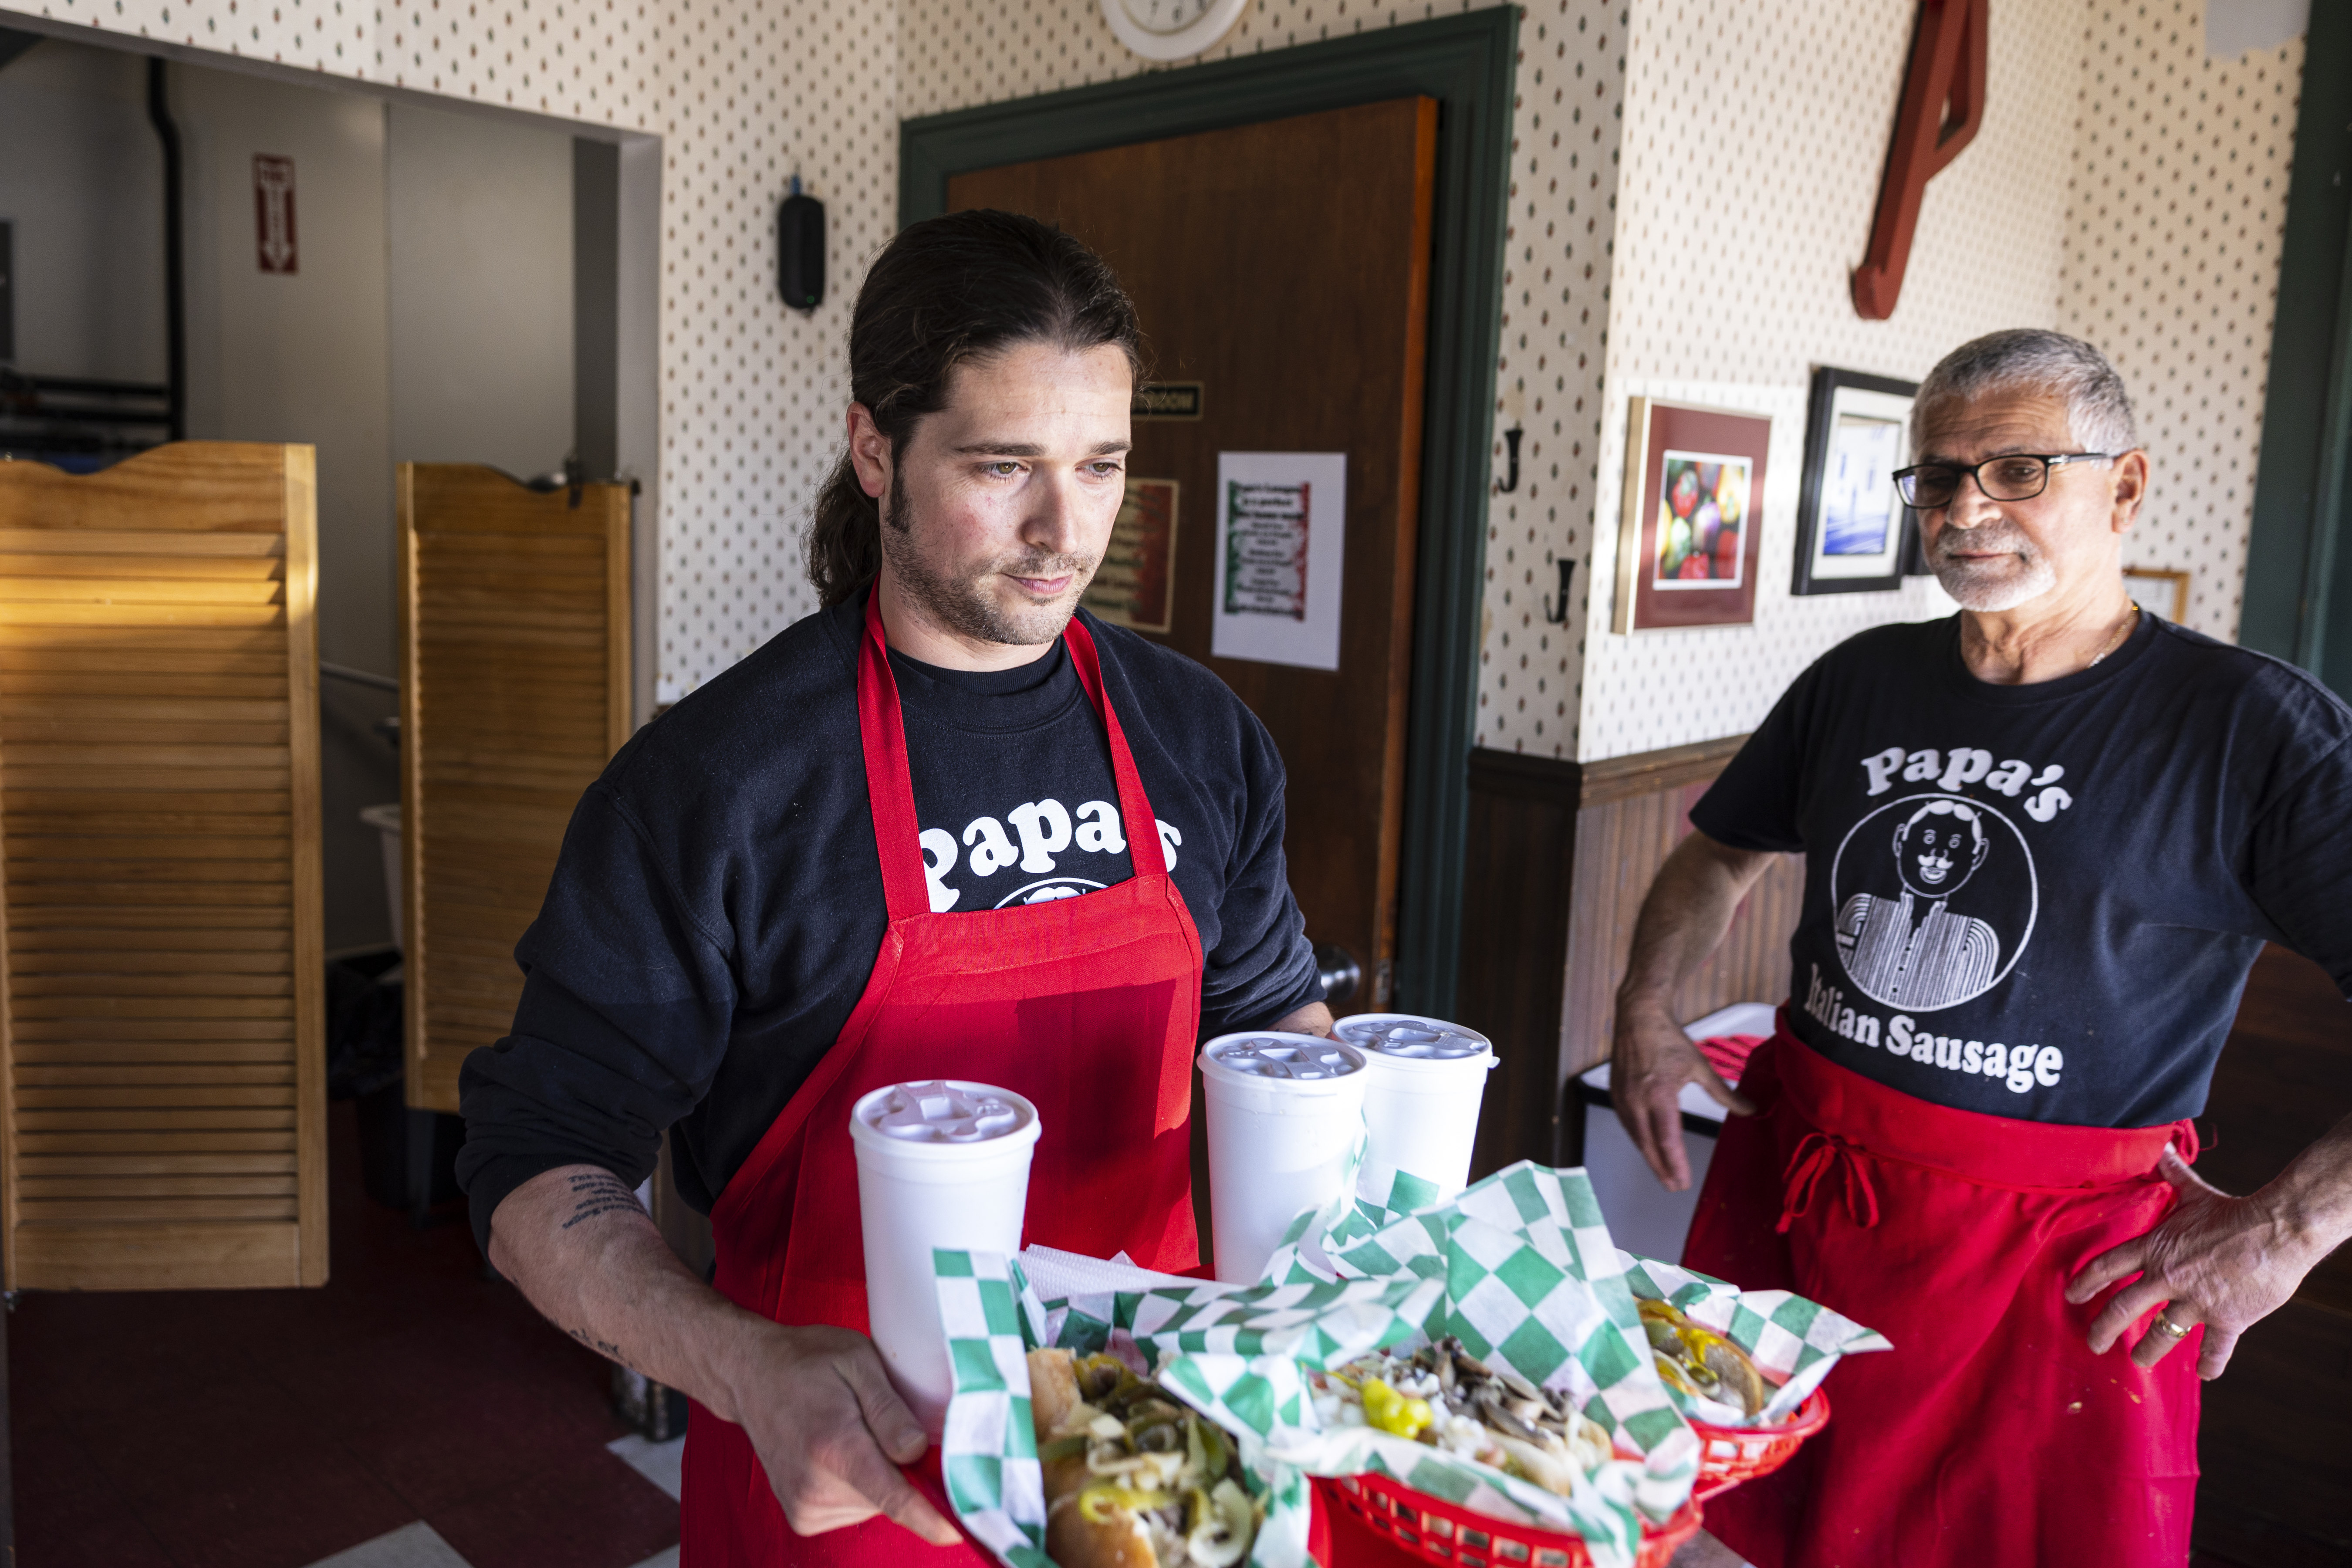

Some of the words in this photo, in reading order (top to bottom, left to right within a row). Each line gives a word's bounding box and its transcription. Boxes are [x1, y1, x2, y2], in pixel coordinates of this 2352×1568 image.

[1861, 747, 2072, 823] Papa's
[1804, 961, 1881, 1048] Italian
[1886, 1014, 2064, 1094] Sausage
